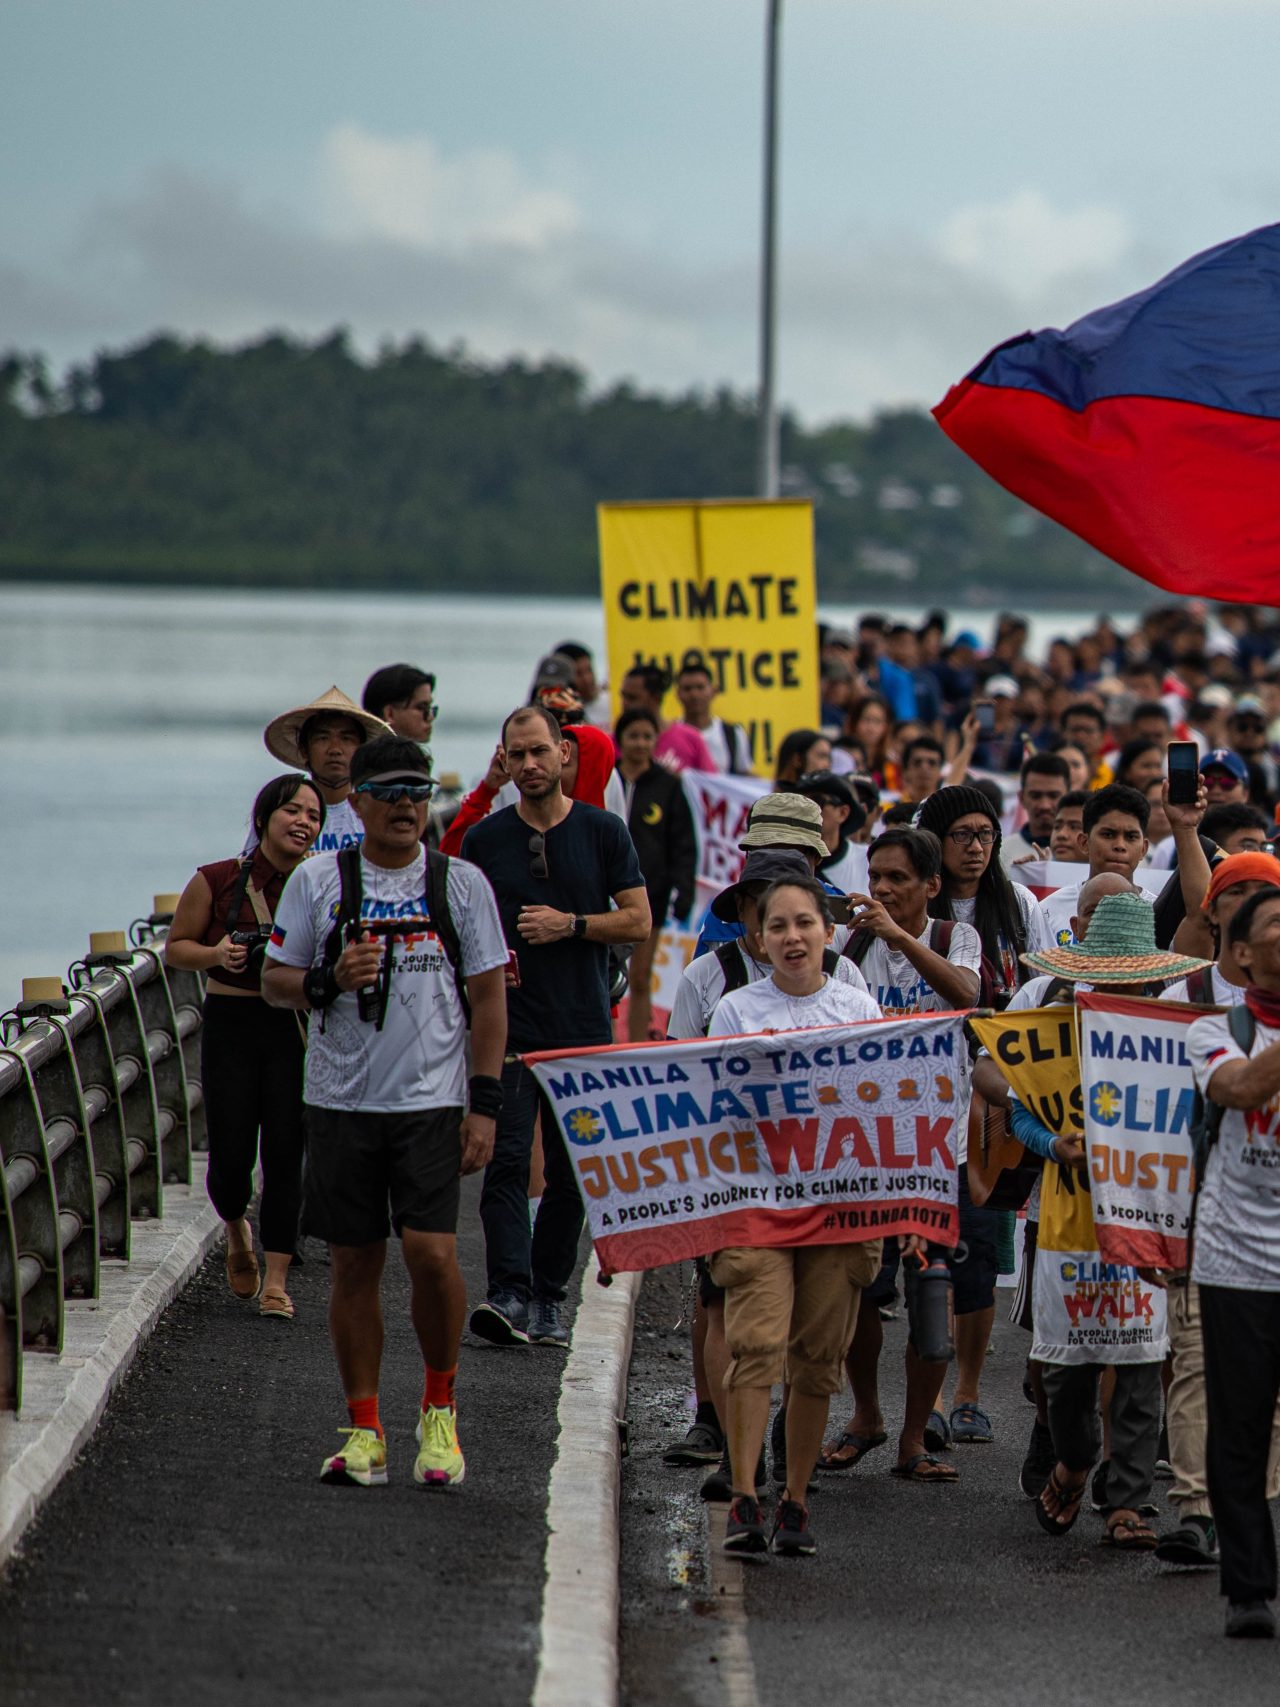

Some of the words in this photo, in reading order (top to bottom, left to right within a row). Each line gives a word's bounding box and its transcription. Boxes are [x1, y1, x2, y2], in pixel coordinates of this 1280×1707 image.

[618, 574, 798, 621] CLIMATE
[548, 1063, 690, 1100] MANILA
[703, 1056, 751, 1081] TO
[765, 1031, 953, 1074] TACLOBAN
[997, 1022, 1081, 1066] CLI
[562, 1080, 814, 1146] CLIMATE
[817, 1075, 954, 1104] 2023
[577, 1131, 759, 1199] JUSTICE
[755, 1115, 956, 1176] WALK
[602, 1213, 612, 1226] A
[618, 1195, 694, 1224] PEOPLE'S
[702, 1186, 768, 1210] JOURNEY
[775, 1182, 804, 1202] FOR
[811, 1177, 878, 1195] CLIMATE
[886, 1175, 949, 1193] JUSTICE
[823, 1207, 951, 1230] #YOLANDA10TH
[1097, 1204, 1105, 1216] A
[1111, 1205, 1174, 1228] PEOPLE'S
[1063, 1293, 1154, 1318] WALK
